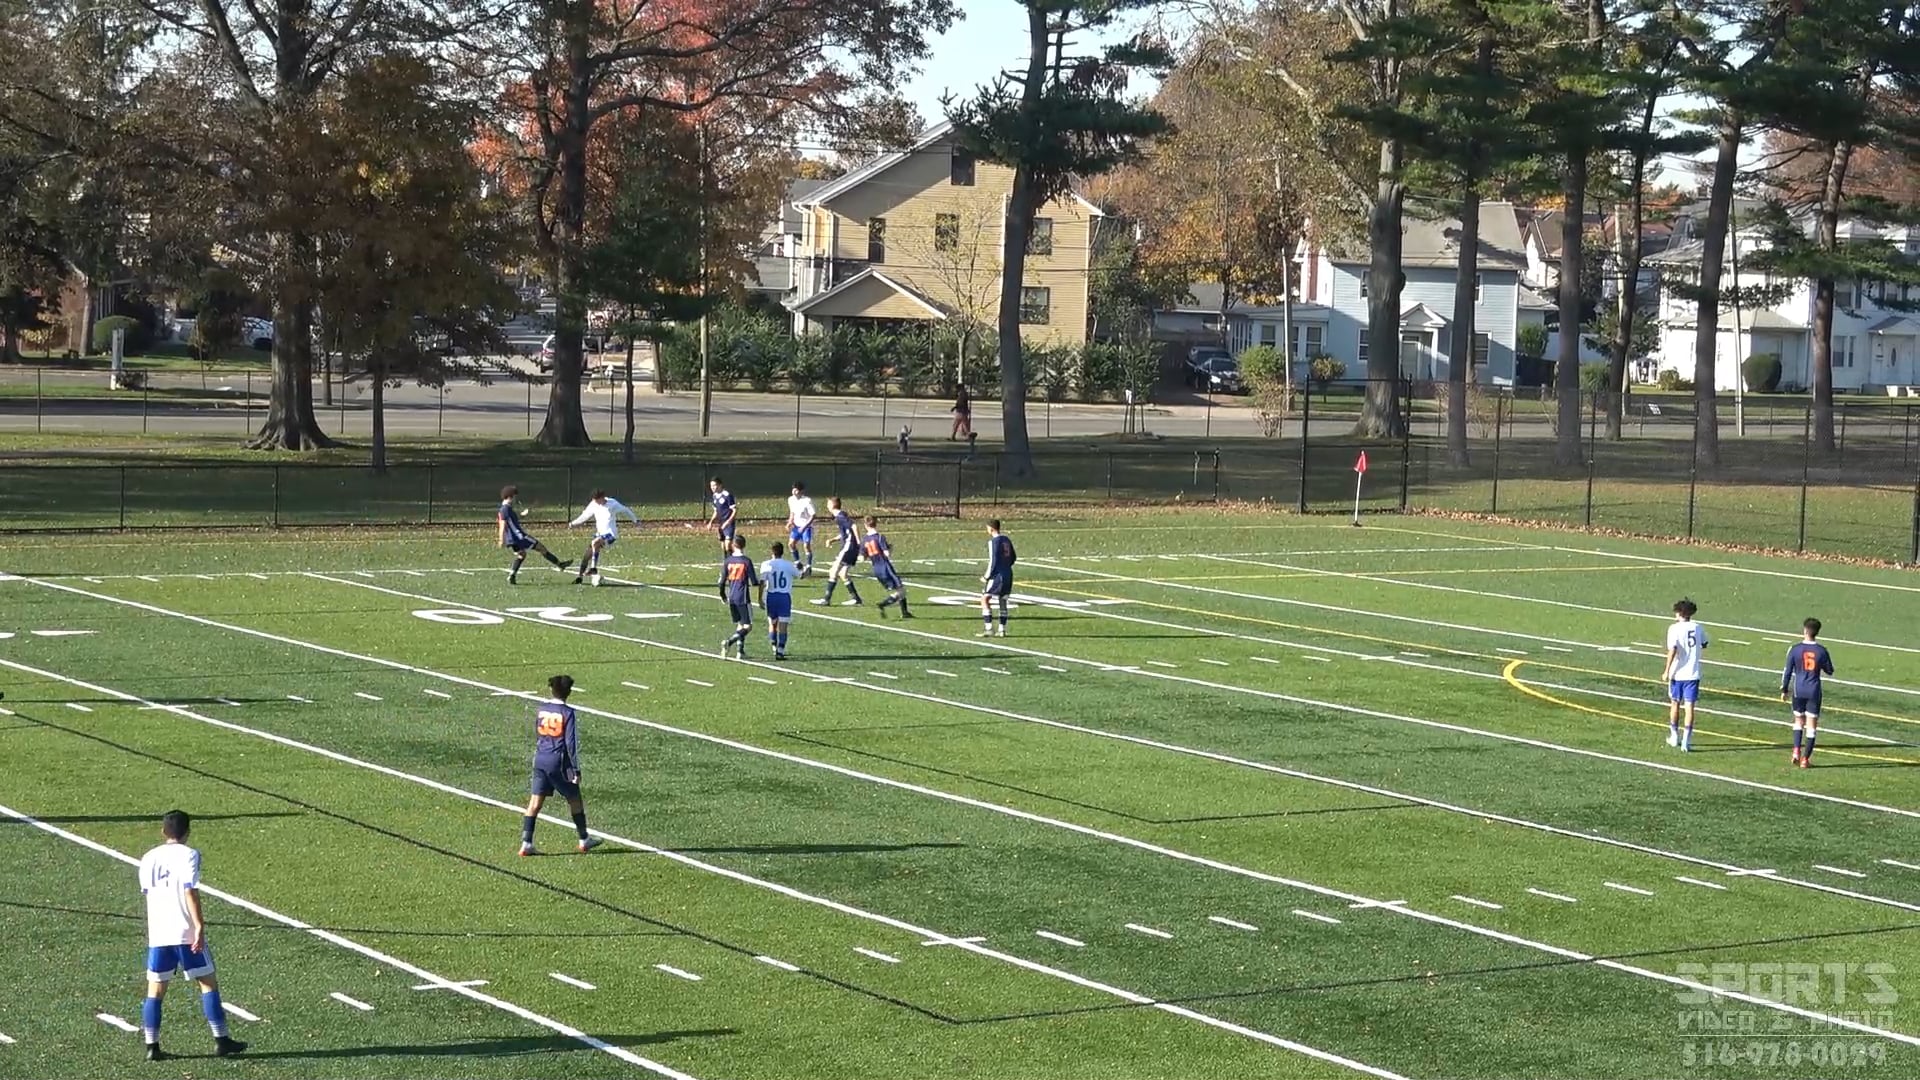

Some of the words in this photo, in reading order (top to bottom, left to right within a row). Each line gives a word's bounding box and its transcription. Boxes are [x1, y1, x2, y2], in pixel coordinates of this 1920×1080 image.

[772, 571, 788, 589] 16
[1687, 630, 1697, 648] 5
[1802, 652, 1817, 671] 6
[537, 710, 563, 738] 39
